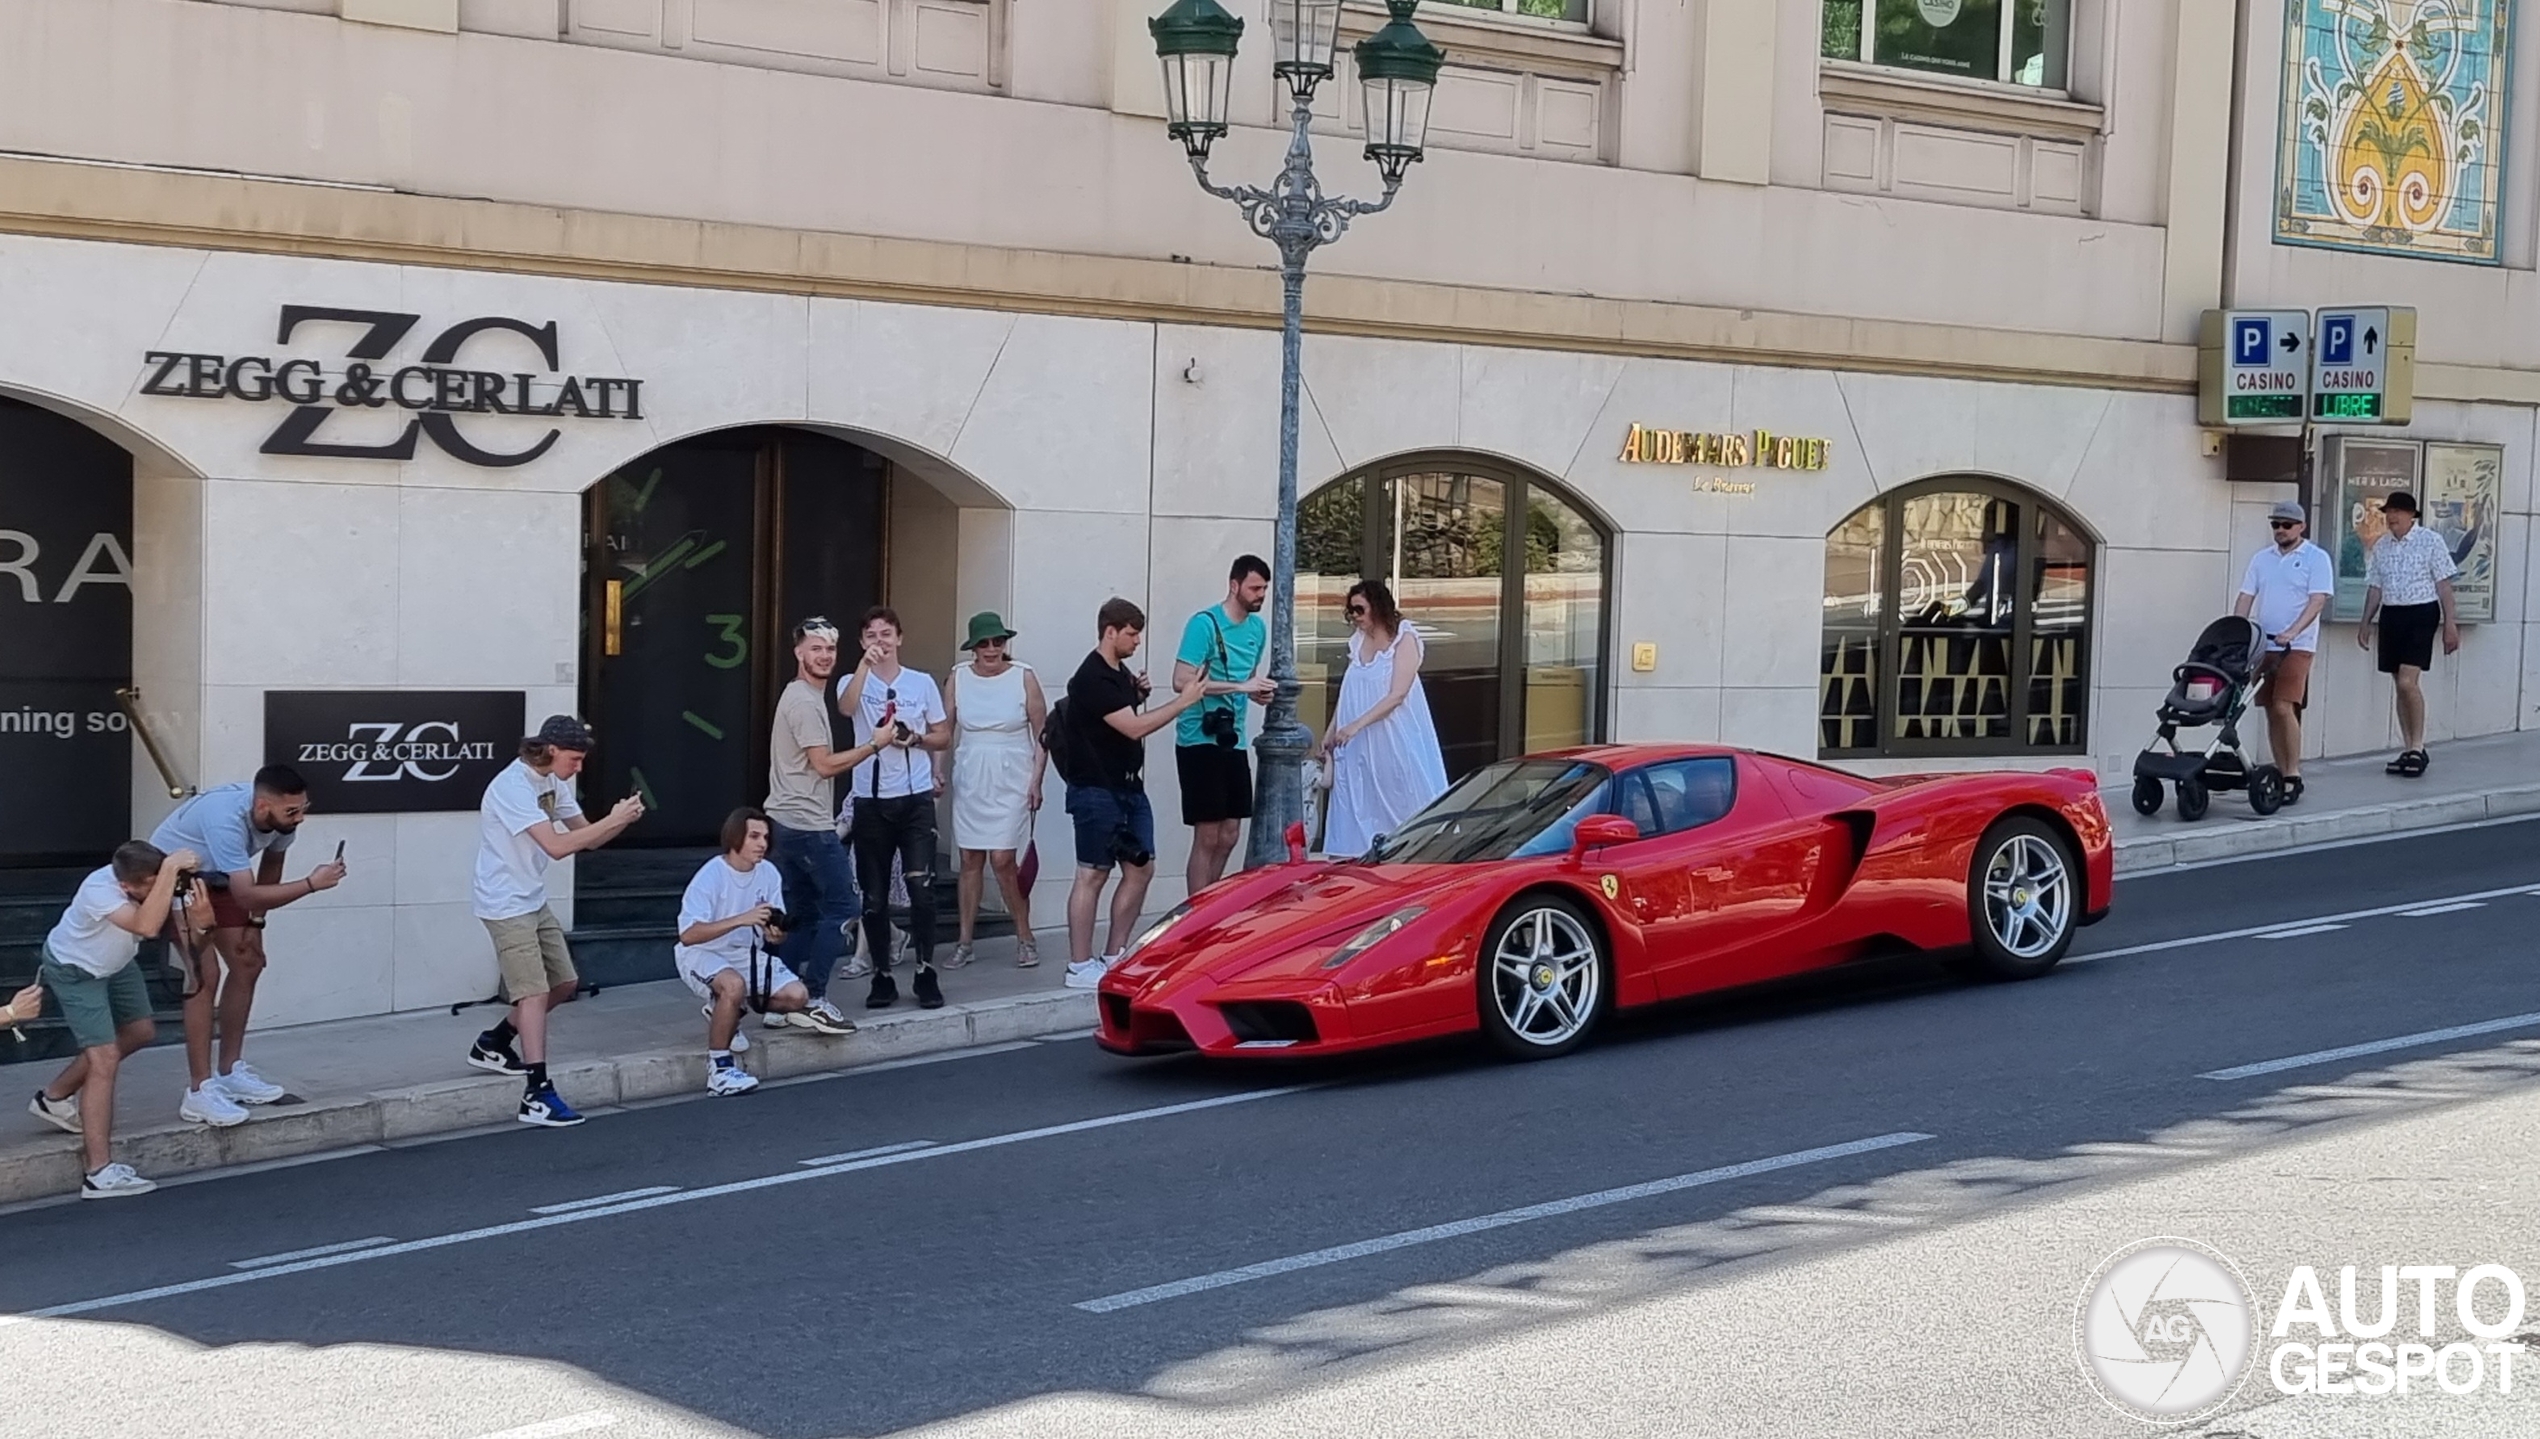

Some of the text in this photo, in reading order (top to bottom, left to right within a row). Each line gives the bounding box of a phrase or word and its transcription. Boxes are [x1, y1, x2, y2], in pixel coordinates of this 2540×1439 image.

[2243, 327, 2262, 357] P
[2330, 325, 2346, 355] P
[139, 350, 322, 406] ZEGG
[2236, 373, 2296, 390] CASINO
[2322, 371, 2375, 388] CASINO
[2322, 394, 2374, 419] LIBRE
[704, 614, 748, 669] 3
[0, 705, 132, 739] ning so
[298, 743, 367, 762] ZEGG
